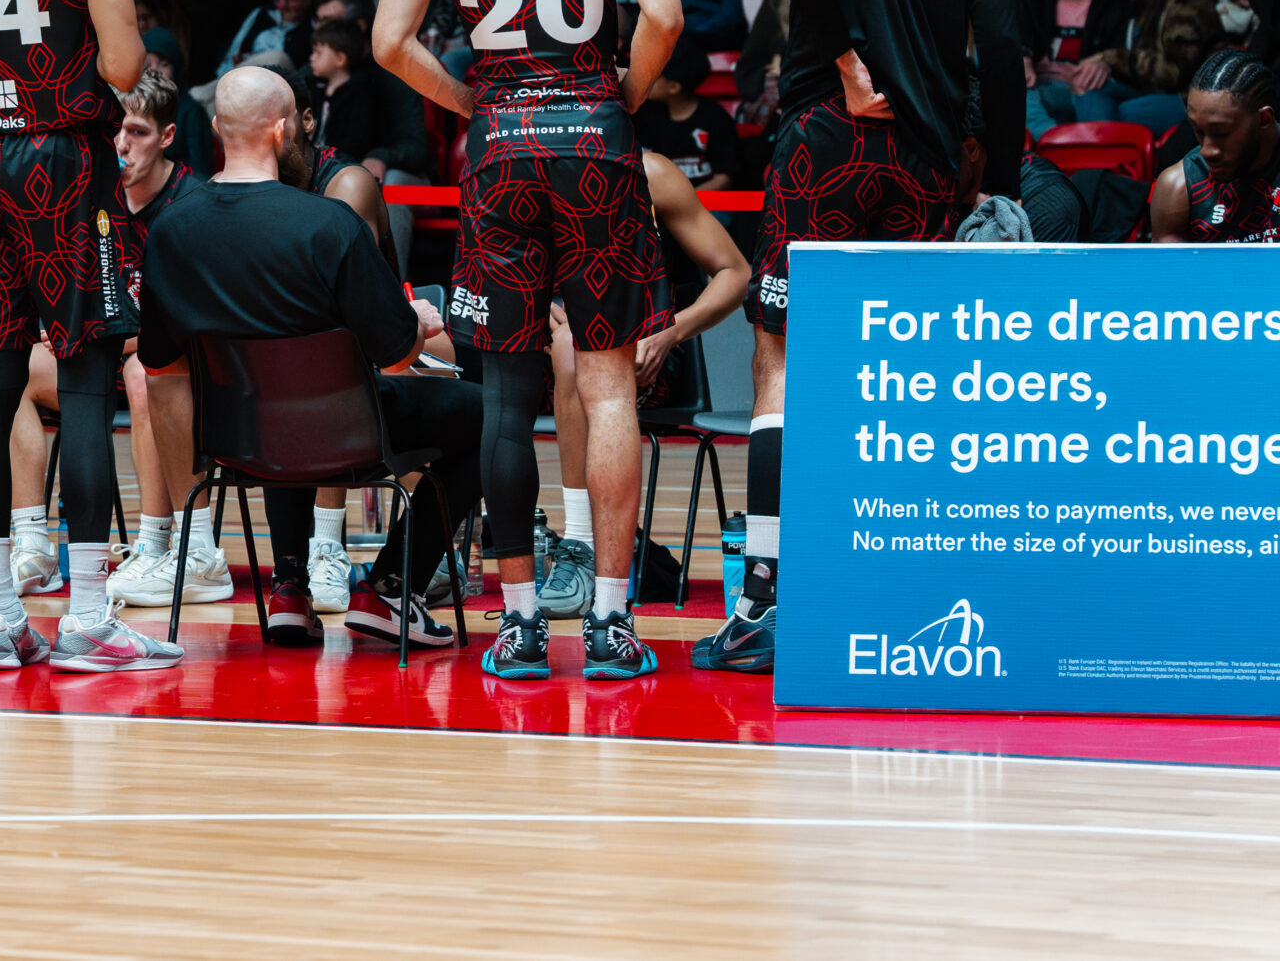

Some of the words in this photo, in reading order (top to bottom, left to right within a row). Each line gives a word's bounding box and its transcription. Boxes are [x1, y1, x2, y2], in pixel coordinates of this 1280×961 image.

[517, 105, 545, 114] Ramsay
[573, 103, 591, 111] Care
[513, 126, 564, 136] CURIOUS
[568, 126, 604, 135] BRAVE
[100, 237, 115, 318] TRAILFINDERS
[761, 274, 788, 293] ESS
[760, 289, 788, 309] SPO
[861, 300, 940, 341] For
[952, 298, 1032, 341] the
[857, 359, 937, 402] the
[952, 359, 1107, 410] doers,
[854, 420, 935, 463] the
[951, 431, 1089, 473] game
[853, 497, 918, 518] When
[926, 498, 940, 518] it
[946, 503, 1020, 519] comes
[1026, 501, 1050, 519] to
[1056, 502, 1174, 524] payments,
[1180, 505, 1214, 520] we
[853, 530, 884, 551] No
[891, 533, 965, 551] matter
[970, 531, 1007, 552] the
[1013, 532, 1056, 552] size
[1062, 532, 1086, 553] of
[1091, 537, 1142, 558] your
[1148, 533, 1253, 558] business,
